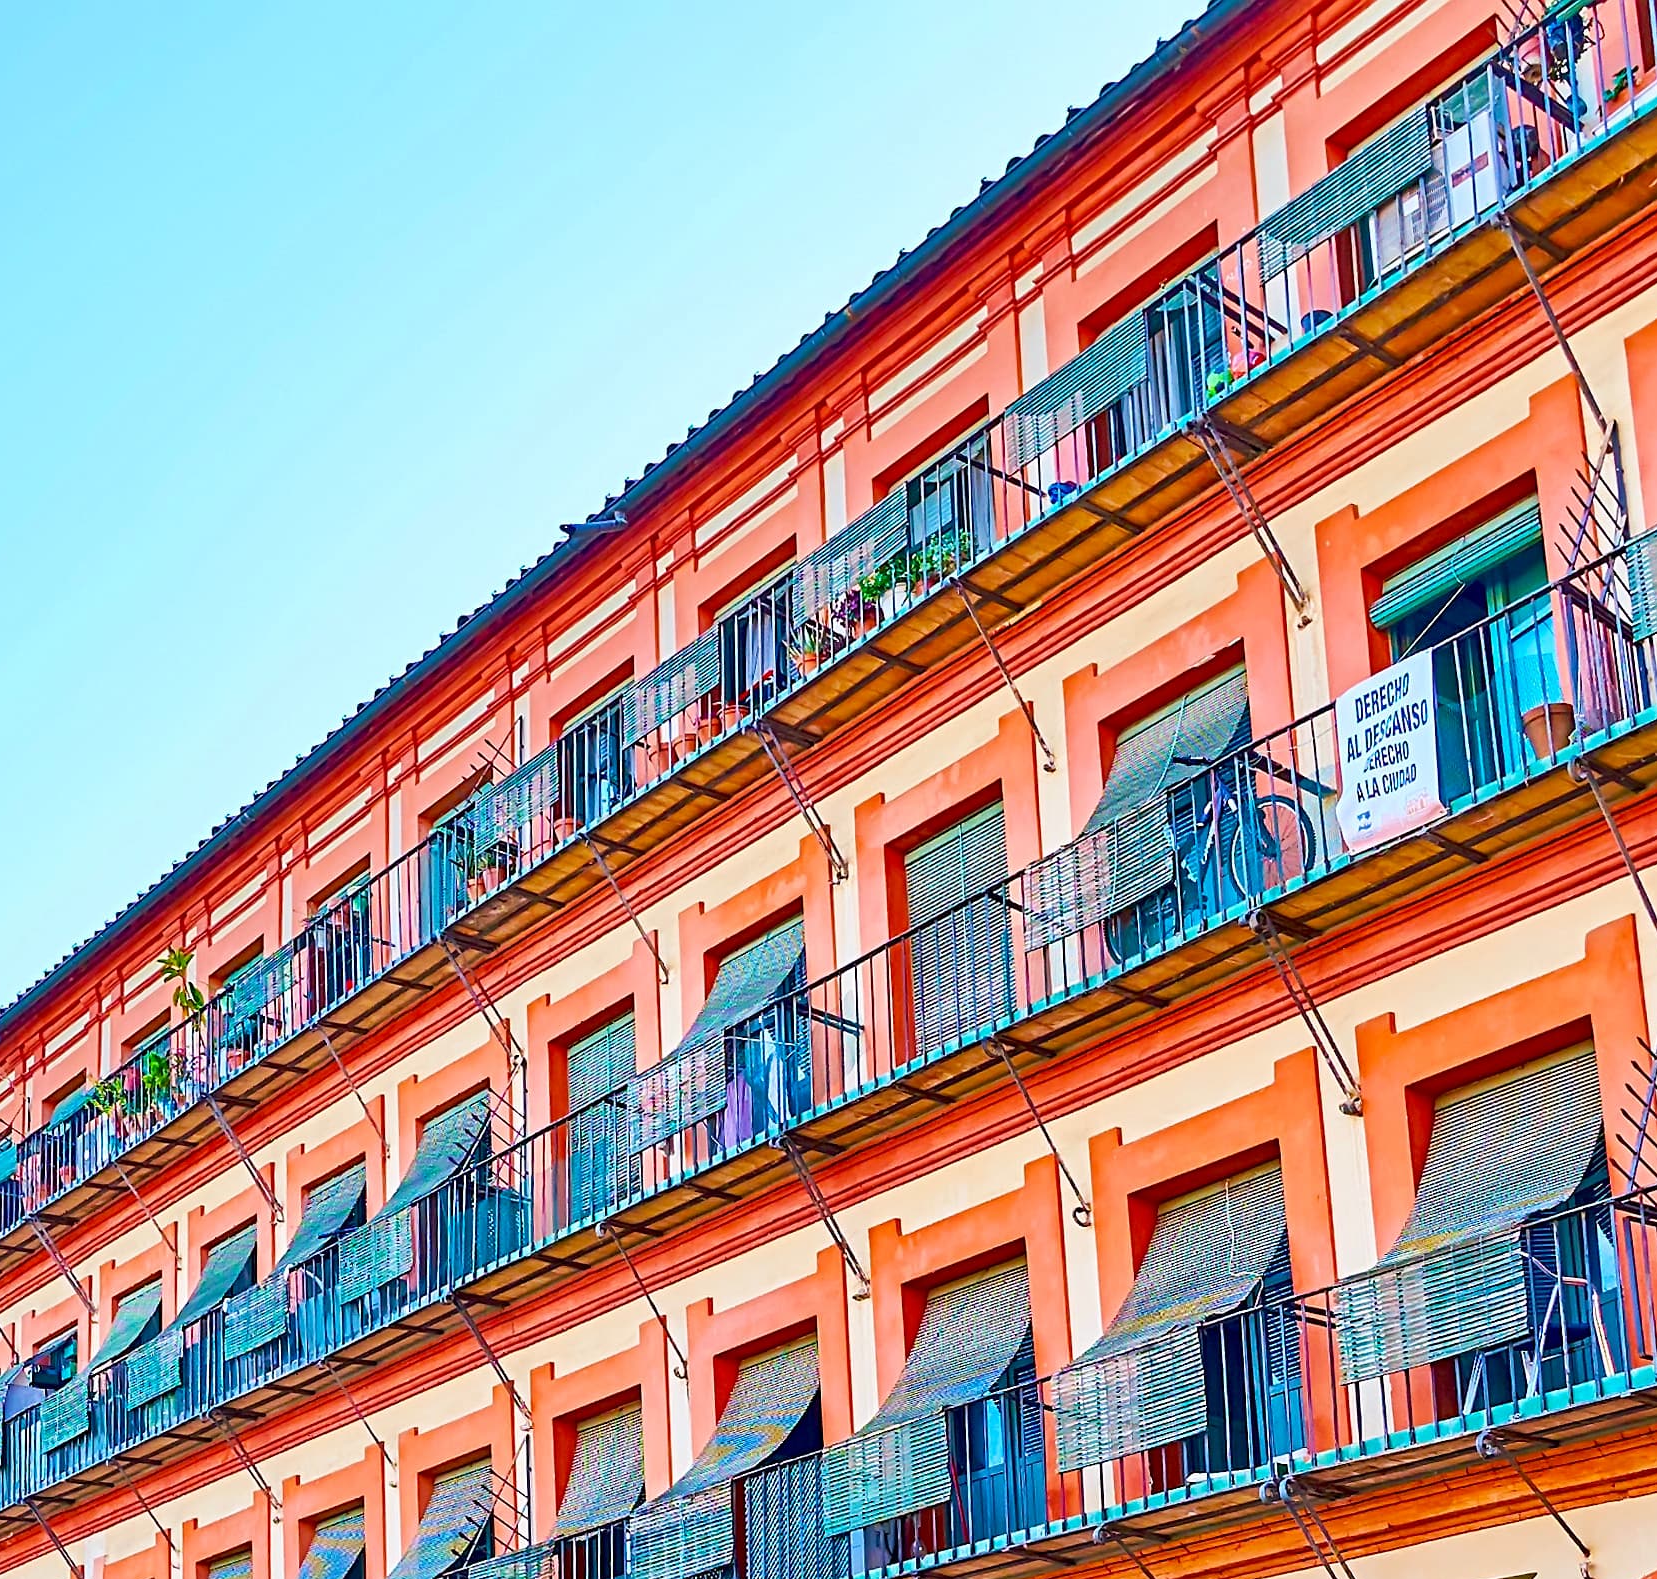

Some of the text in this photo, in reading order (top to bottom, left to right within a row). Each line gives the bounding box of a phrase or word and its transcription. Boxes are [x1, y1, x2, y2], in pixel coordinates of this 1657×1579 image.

[1355, 672, 1409, 723] DERECHO
[1347, 699, 1428, 763] AL DESCANSO
[1356, 763, 1417, 803] A LA CIUDAD
